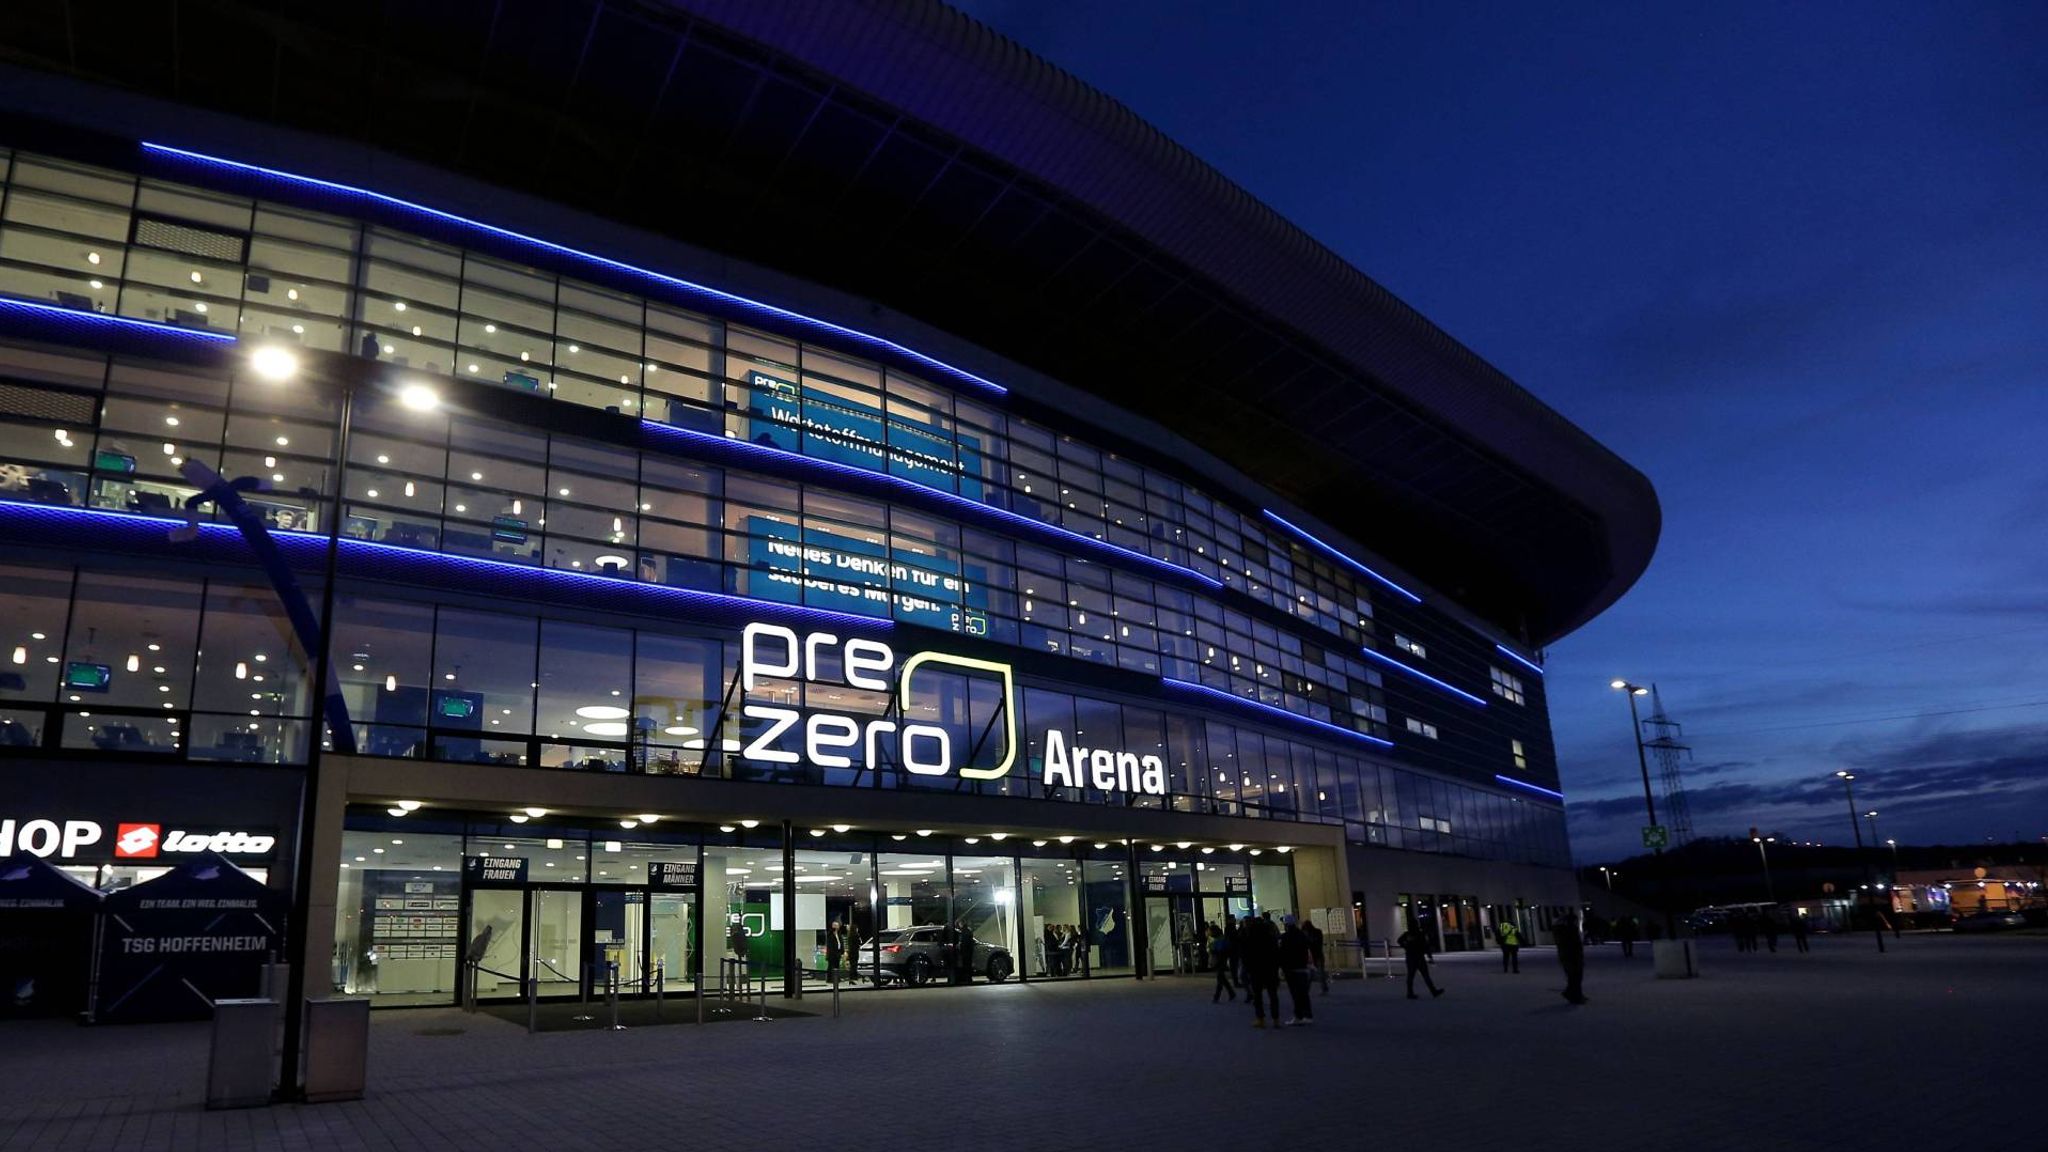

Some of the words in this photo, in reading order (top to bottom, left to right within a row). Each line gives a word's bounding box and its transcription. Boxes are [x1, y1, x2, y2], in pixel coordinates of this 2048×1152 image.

[767, 534, 832, 565] Neues
[836, 553, 908, 580] Denken
[743, 622, 895, 692] pre
[743, 705, 951, 776] zero
[1043, 729, 1166, 795] Arena
[483, 858, 522, 869] EINGANG
[483, 869, 516, 880] FRAUEN
[663, 863, 696, 874] EINGANG
[123, 937, 156, 953] TSG
[159, 935, 267, 952] HOFFENHEIM
